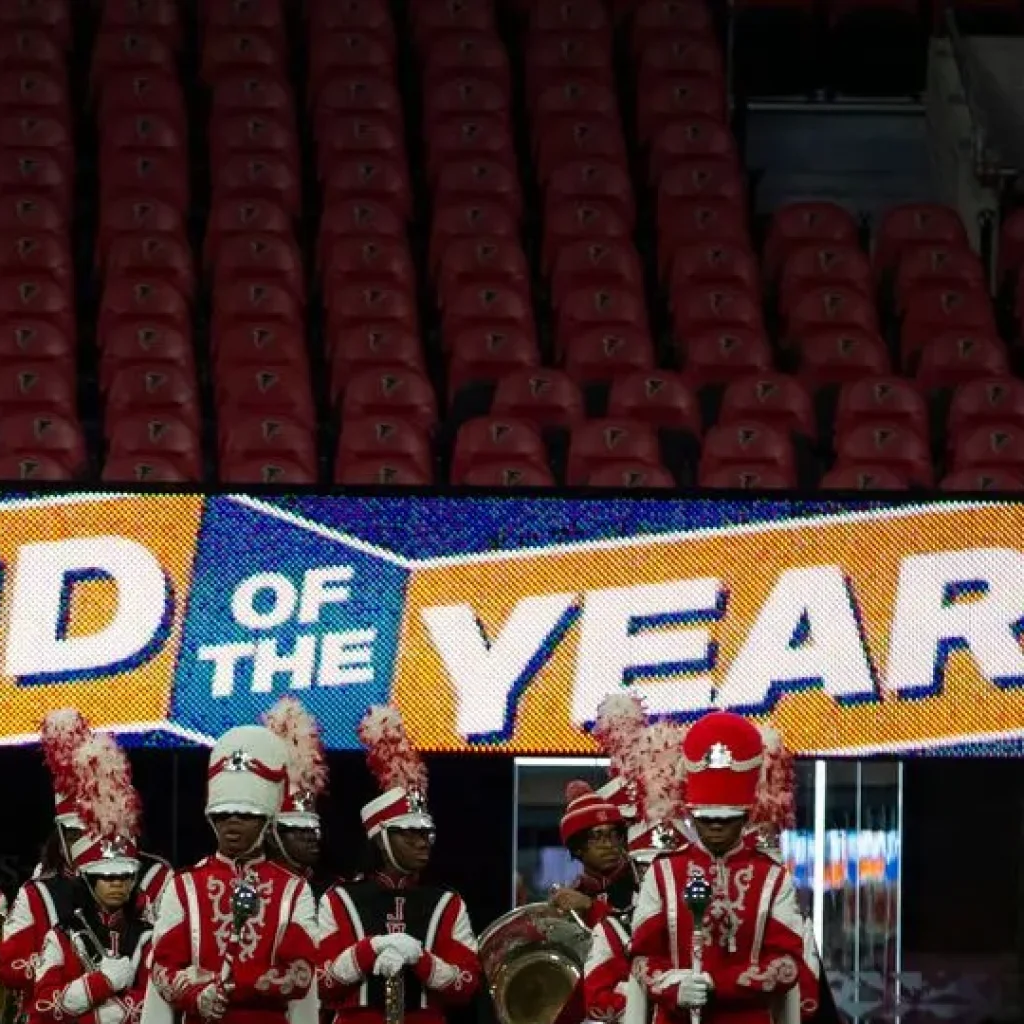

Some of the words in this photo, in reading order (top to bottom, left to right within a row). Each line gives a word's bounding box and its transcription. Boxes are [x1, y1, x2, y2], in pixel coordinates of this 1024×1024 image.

[231, 566, 353, 630] OF
[196, 628, 376, 698] THE
[422, 547, 1024, 740] YEAR
